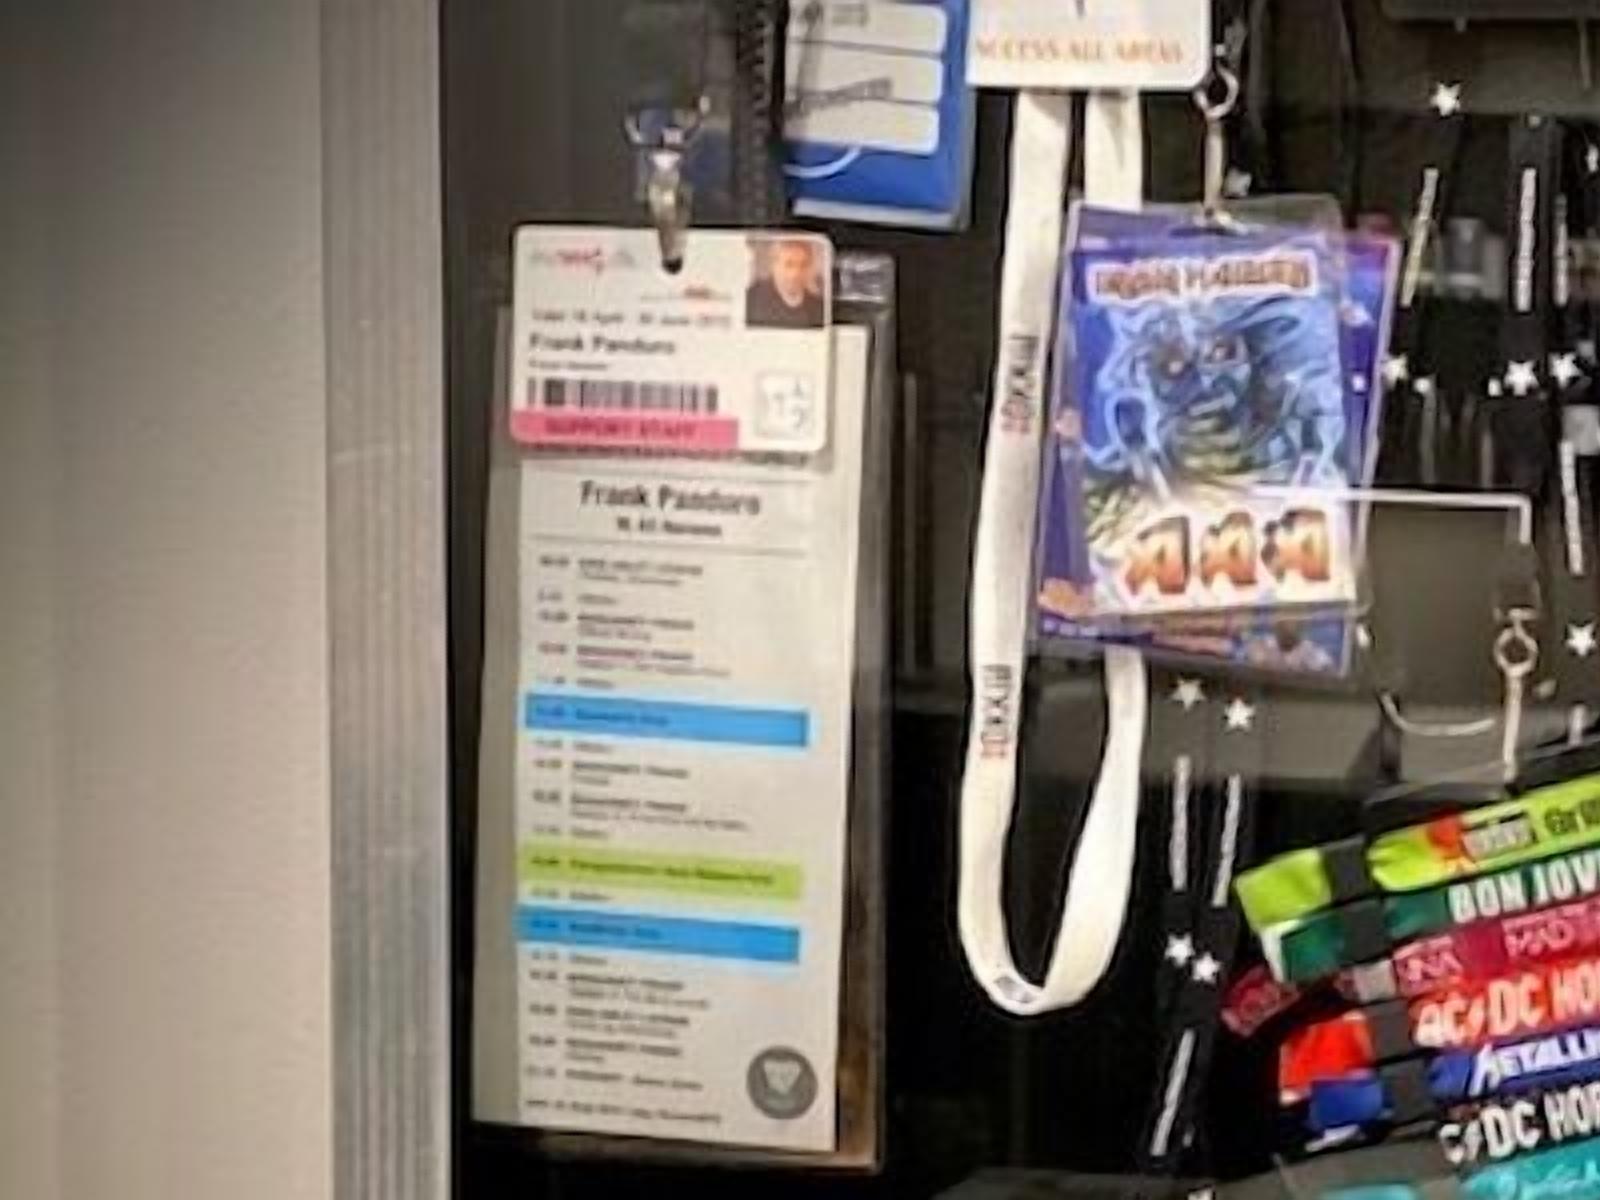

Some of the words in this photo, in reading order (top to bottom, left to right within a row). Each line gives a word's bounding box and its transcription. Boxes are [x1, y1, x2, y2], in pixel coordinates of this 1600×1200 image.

[579, 479, 648, 507] Frank
[1448, 868, 1529, 924] BON
[1438, 1100, 1542, 1164] C/DC
